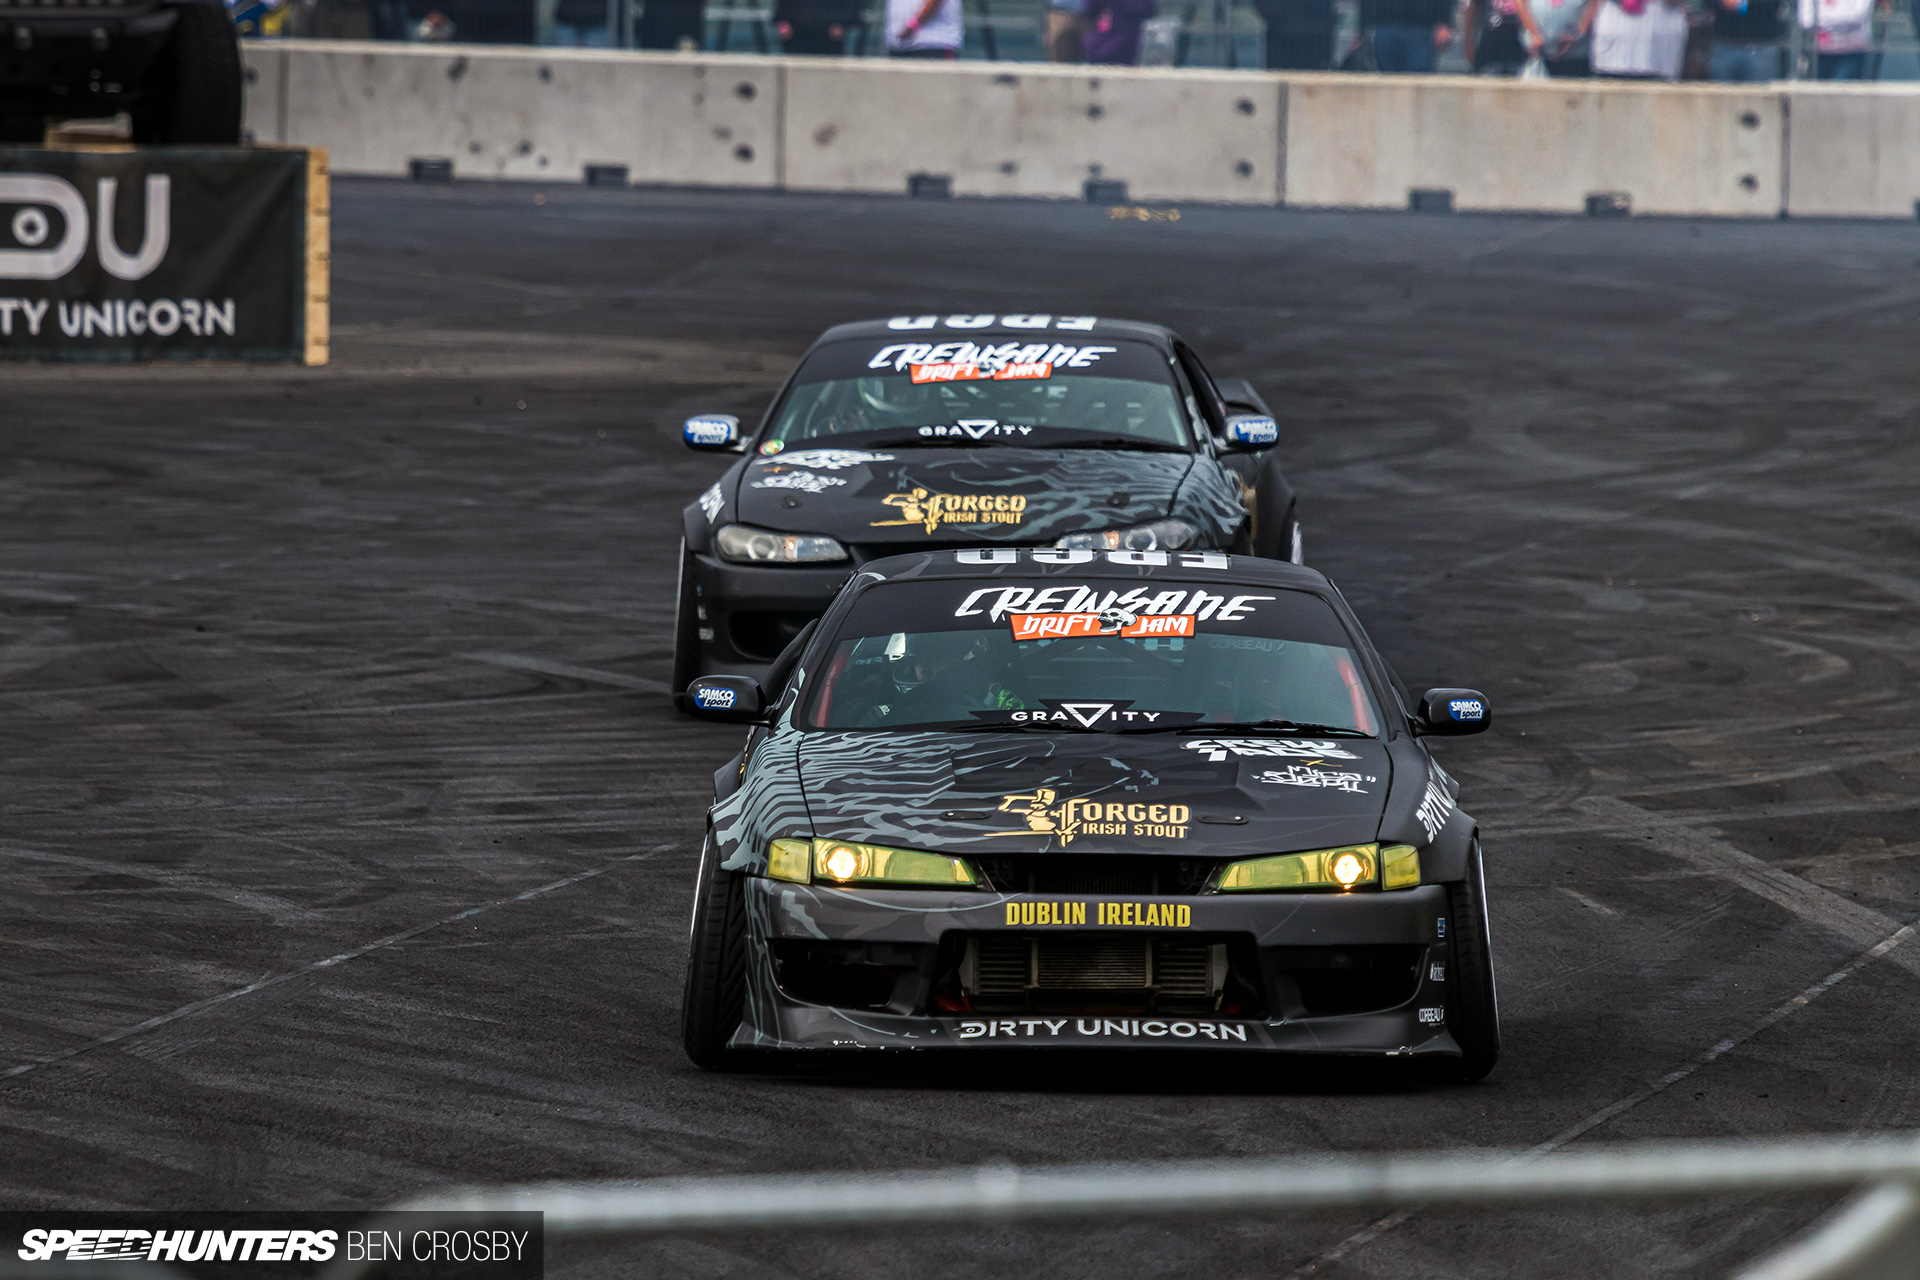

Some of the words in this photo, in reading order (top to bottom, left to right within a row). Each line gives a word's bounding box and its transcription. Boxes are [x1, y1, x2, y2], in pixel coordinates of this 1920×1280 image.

[58, 298, 235, 338] UNICORN
[914, 363, 979, 381] DRIFT
[1001, 363, 1049, 378] JAM
[918, 419, 1033, 439] GRAVITY
[930, 494, 1027, 512] FORGED
[943, 511, 978, 523] IRISH
[981, 512, 1024, 524] STOUT
[954, 585, 1276, 623] CREWSANE
[1022, 613, 1100, 636] DRIFT
[1138, 615, 1188, 634] JAM
[698, 688, 735, 700] SAMCO
[705, 698, 731, 707] sport
[1011, 703, 1161, 728] GRAVITY
[1450, 701, 1482, 712] SAMCO
[1461, 709, 1481, 719] sport
[1064, 798, 1190, 826] FORGED
[1082, 822, 1127, 835] IRISH
[1134, 823, 1189, 839] STOUT
[1006, 902, 1086, 926] DUBLIN
[1098, 902, 1191, 928] IRELAND
[960, 1019, 1068, 1039] DIRTY
[1077, 1019, 1247, 1042] UNICORN
